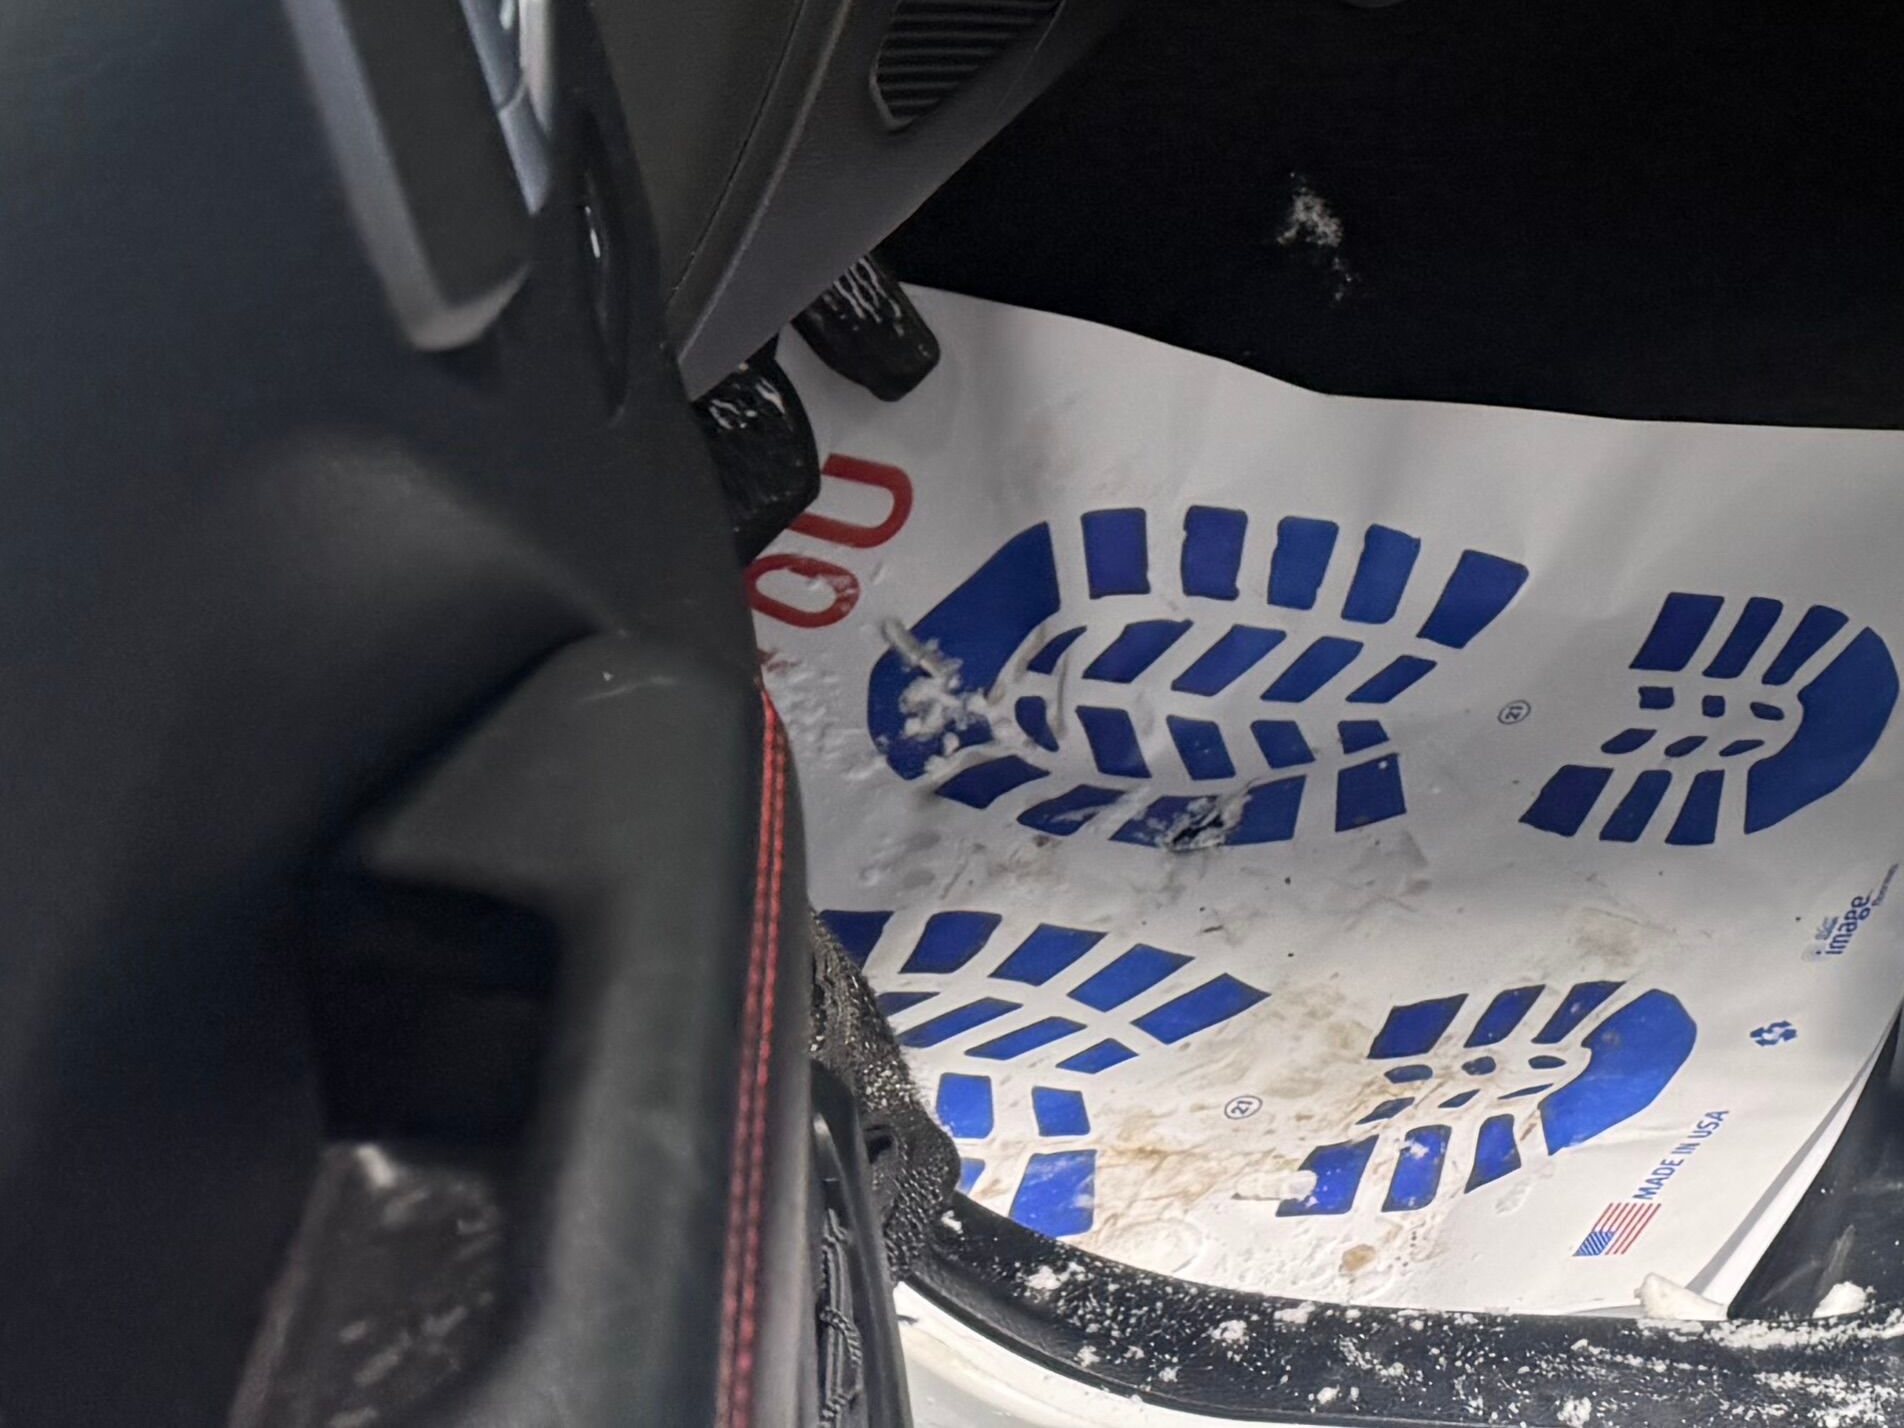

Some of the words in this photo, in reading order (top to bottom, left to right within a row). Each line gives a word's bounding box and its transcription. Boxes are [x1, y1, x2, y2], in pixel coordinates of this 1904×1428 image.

[1632, 1158, 1685, 1201] MADE
[1670, 1142, 1702, 1155] IN
[1687, 1110, 1731, 1140] USA
